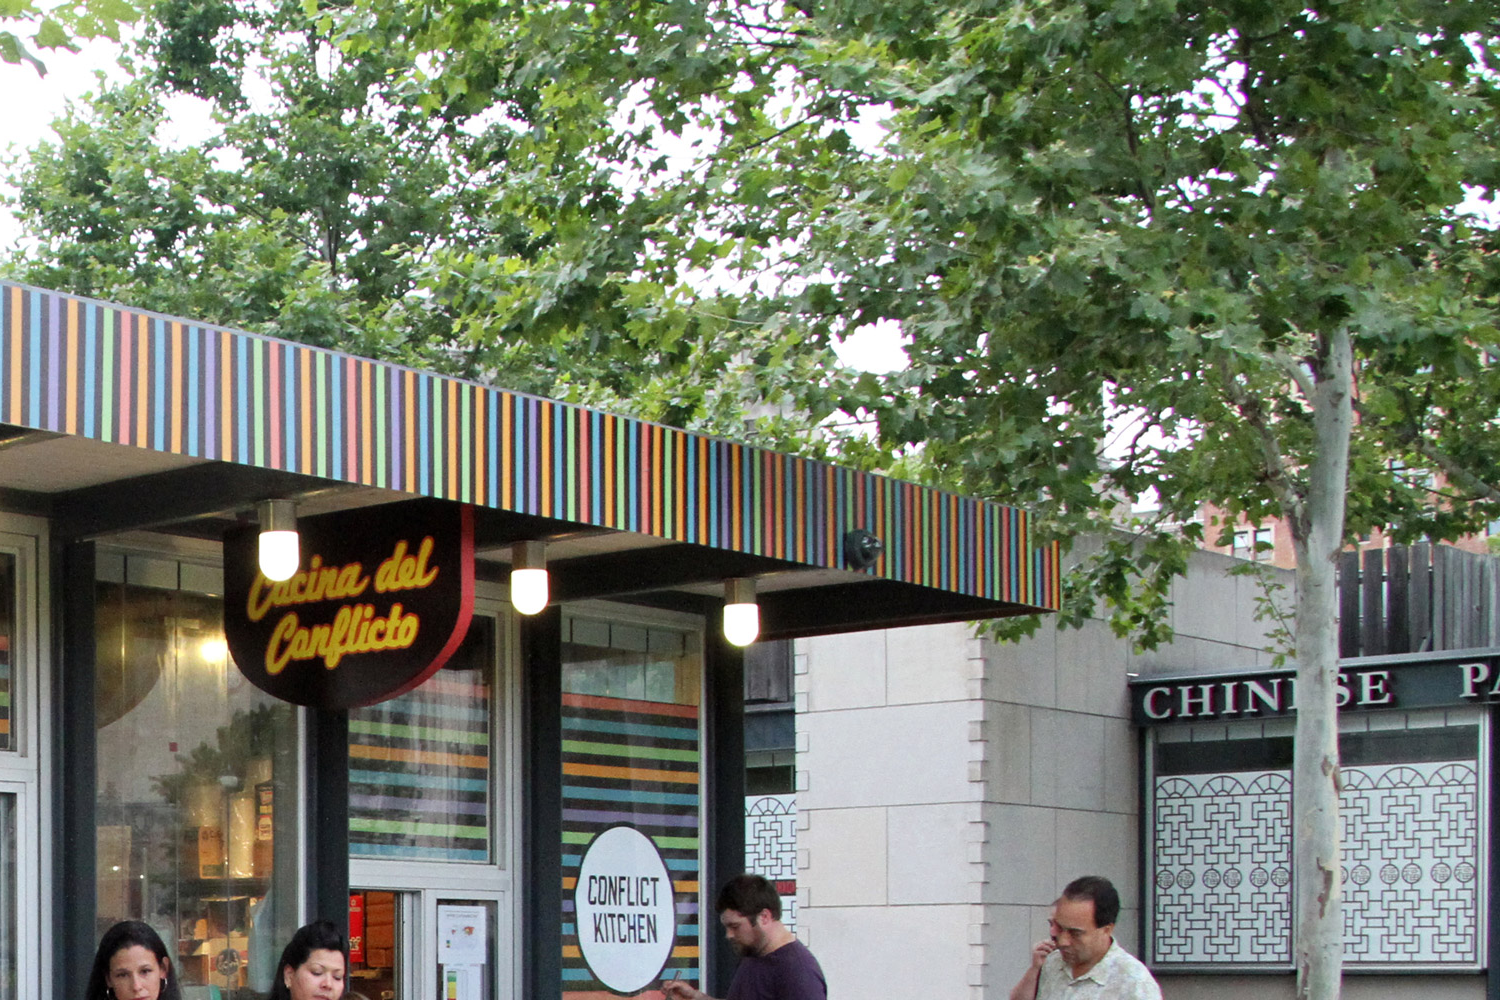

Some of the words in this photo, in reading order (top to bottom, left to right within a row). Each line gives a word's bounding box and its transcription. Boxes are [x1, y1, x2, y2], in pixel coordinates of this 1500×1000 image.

[247, 555, 370, 621] Cocina
[374, 535, 440, 594] del
[265, 603, 420, 674] Conflicto
[1142, 669, 1393, 720] CHINSE
[588, 875, 659, 906] CONFLICT
[594, 912, 658, 944] KITCHEN
